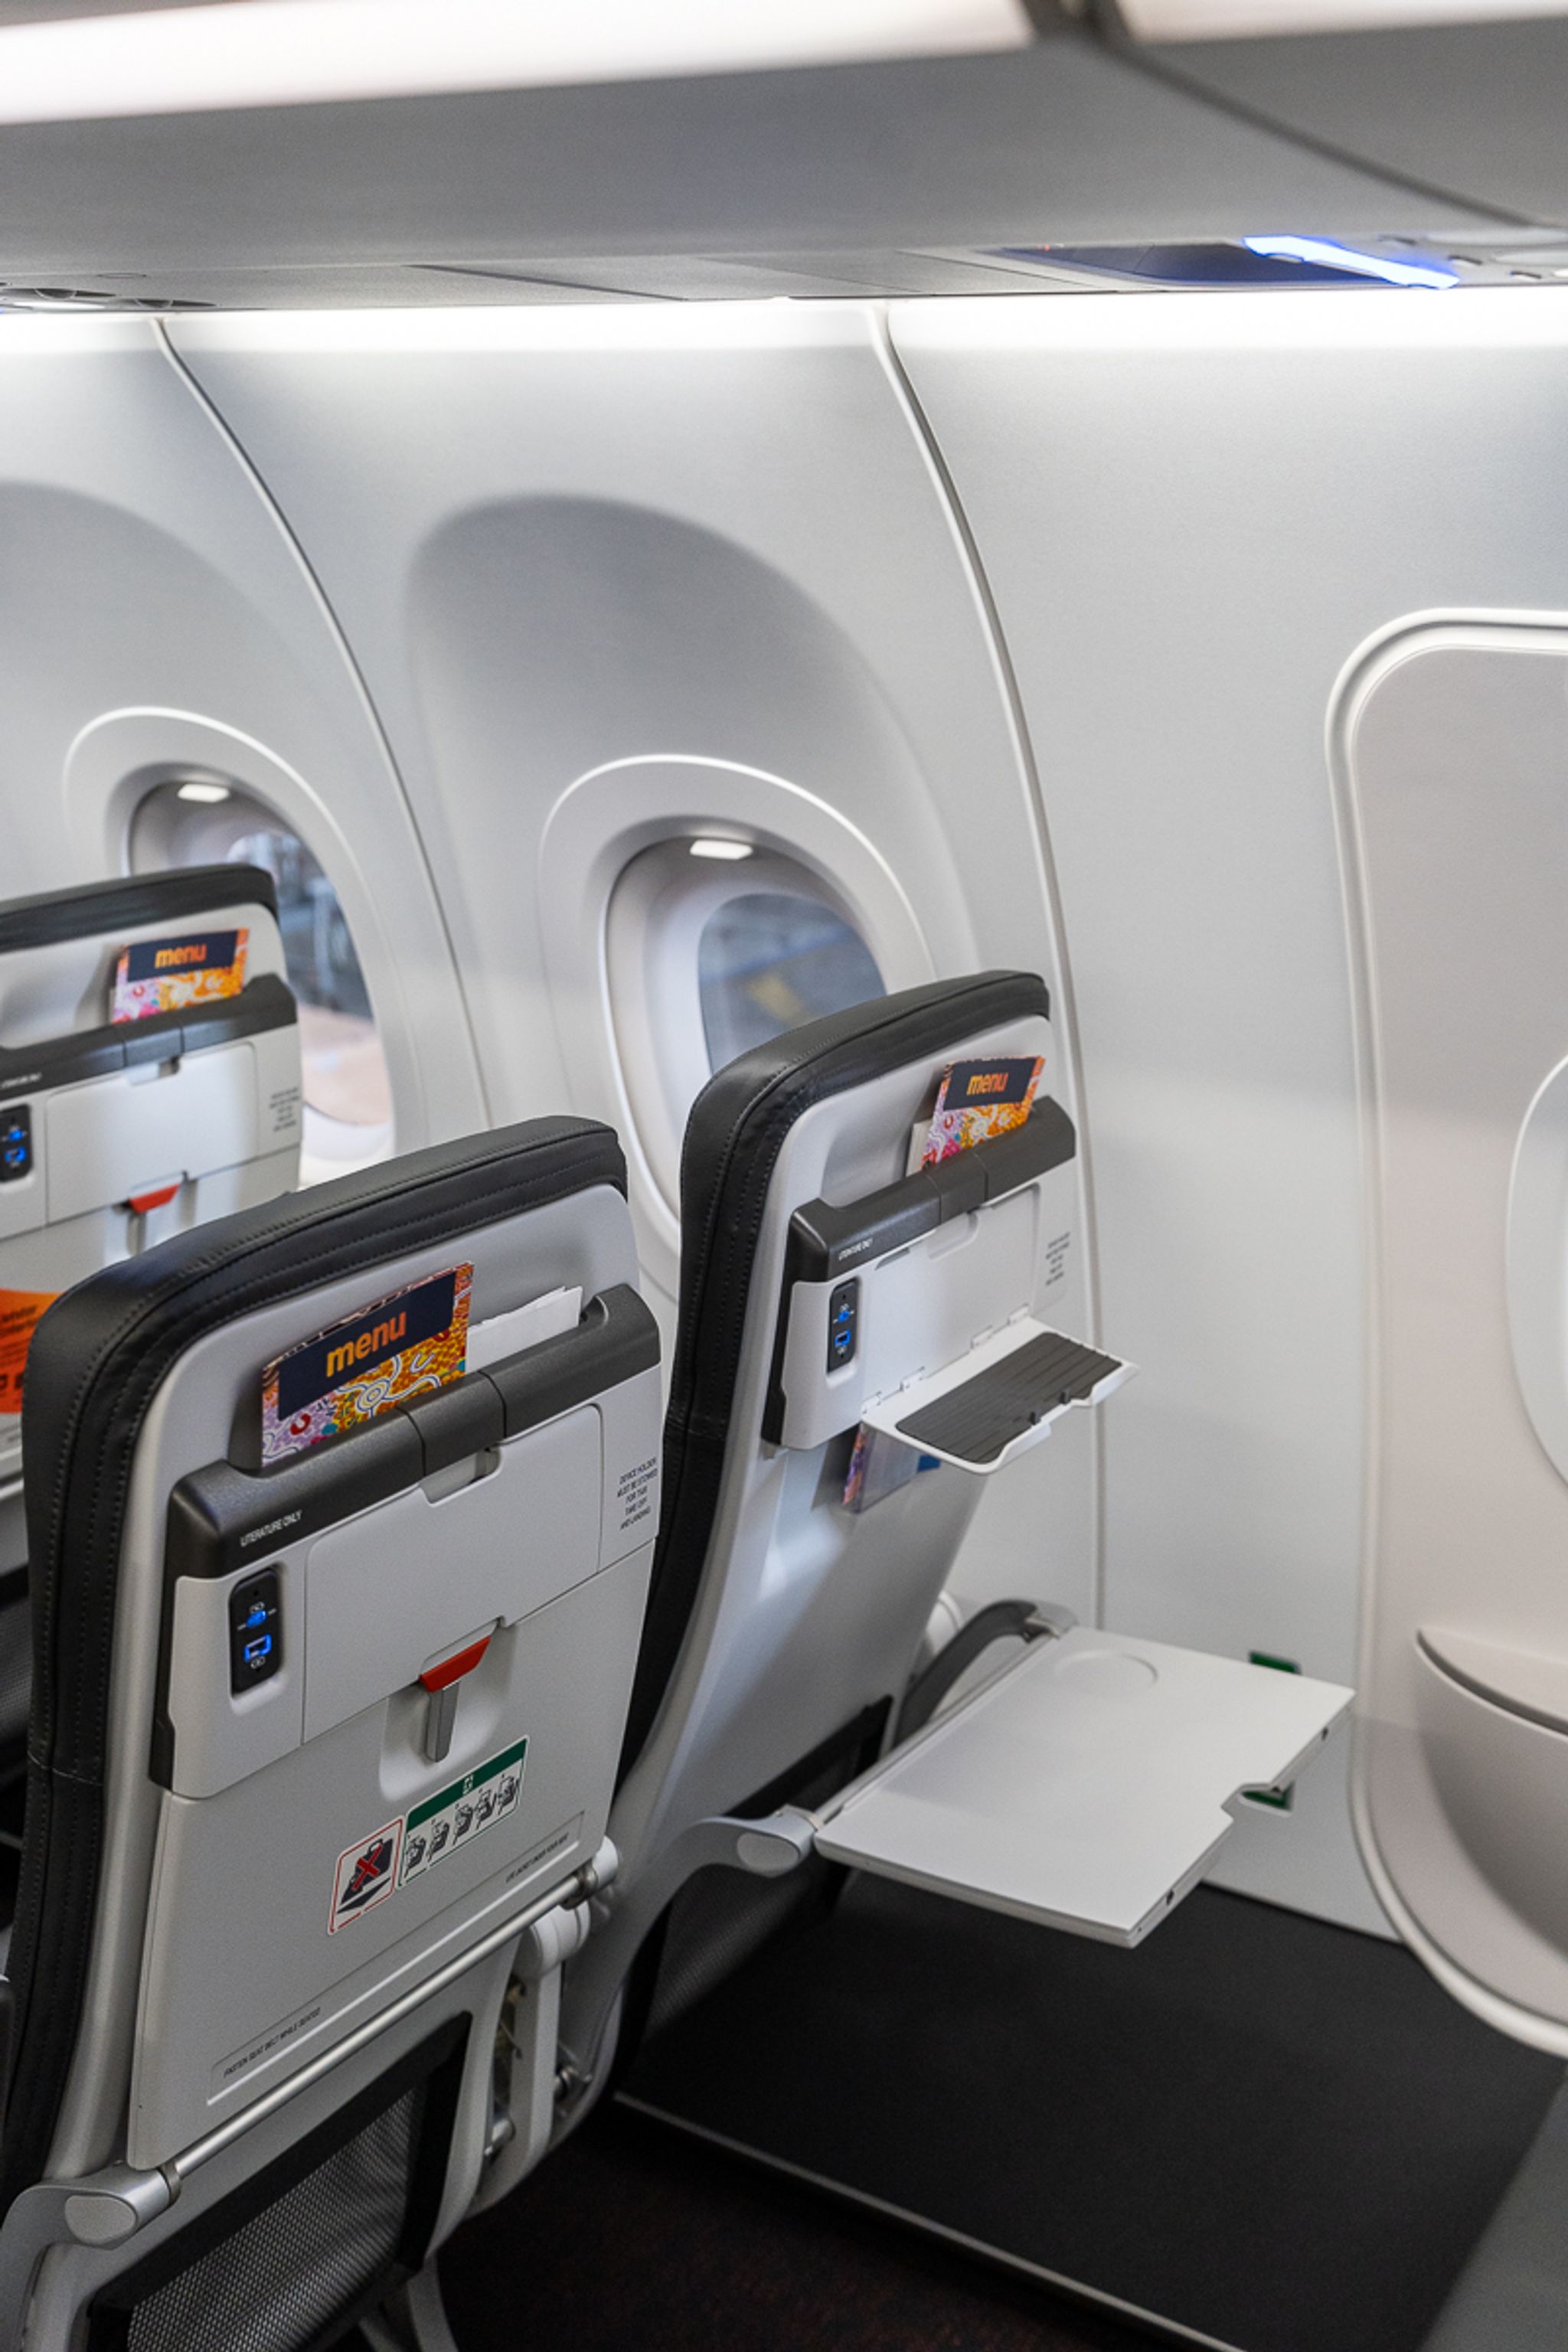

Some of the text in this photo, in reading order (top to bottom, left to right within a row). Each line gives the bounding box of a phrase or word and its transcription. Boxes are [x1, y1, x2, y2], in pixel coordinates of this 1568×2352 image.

[155, 944, 207, 969] menu
[966, 1073, 1009, 1096] menu
[326, 1312, 407, 1377] menu
[240, 1509, 302, 1547] LITERATURE ONLY
